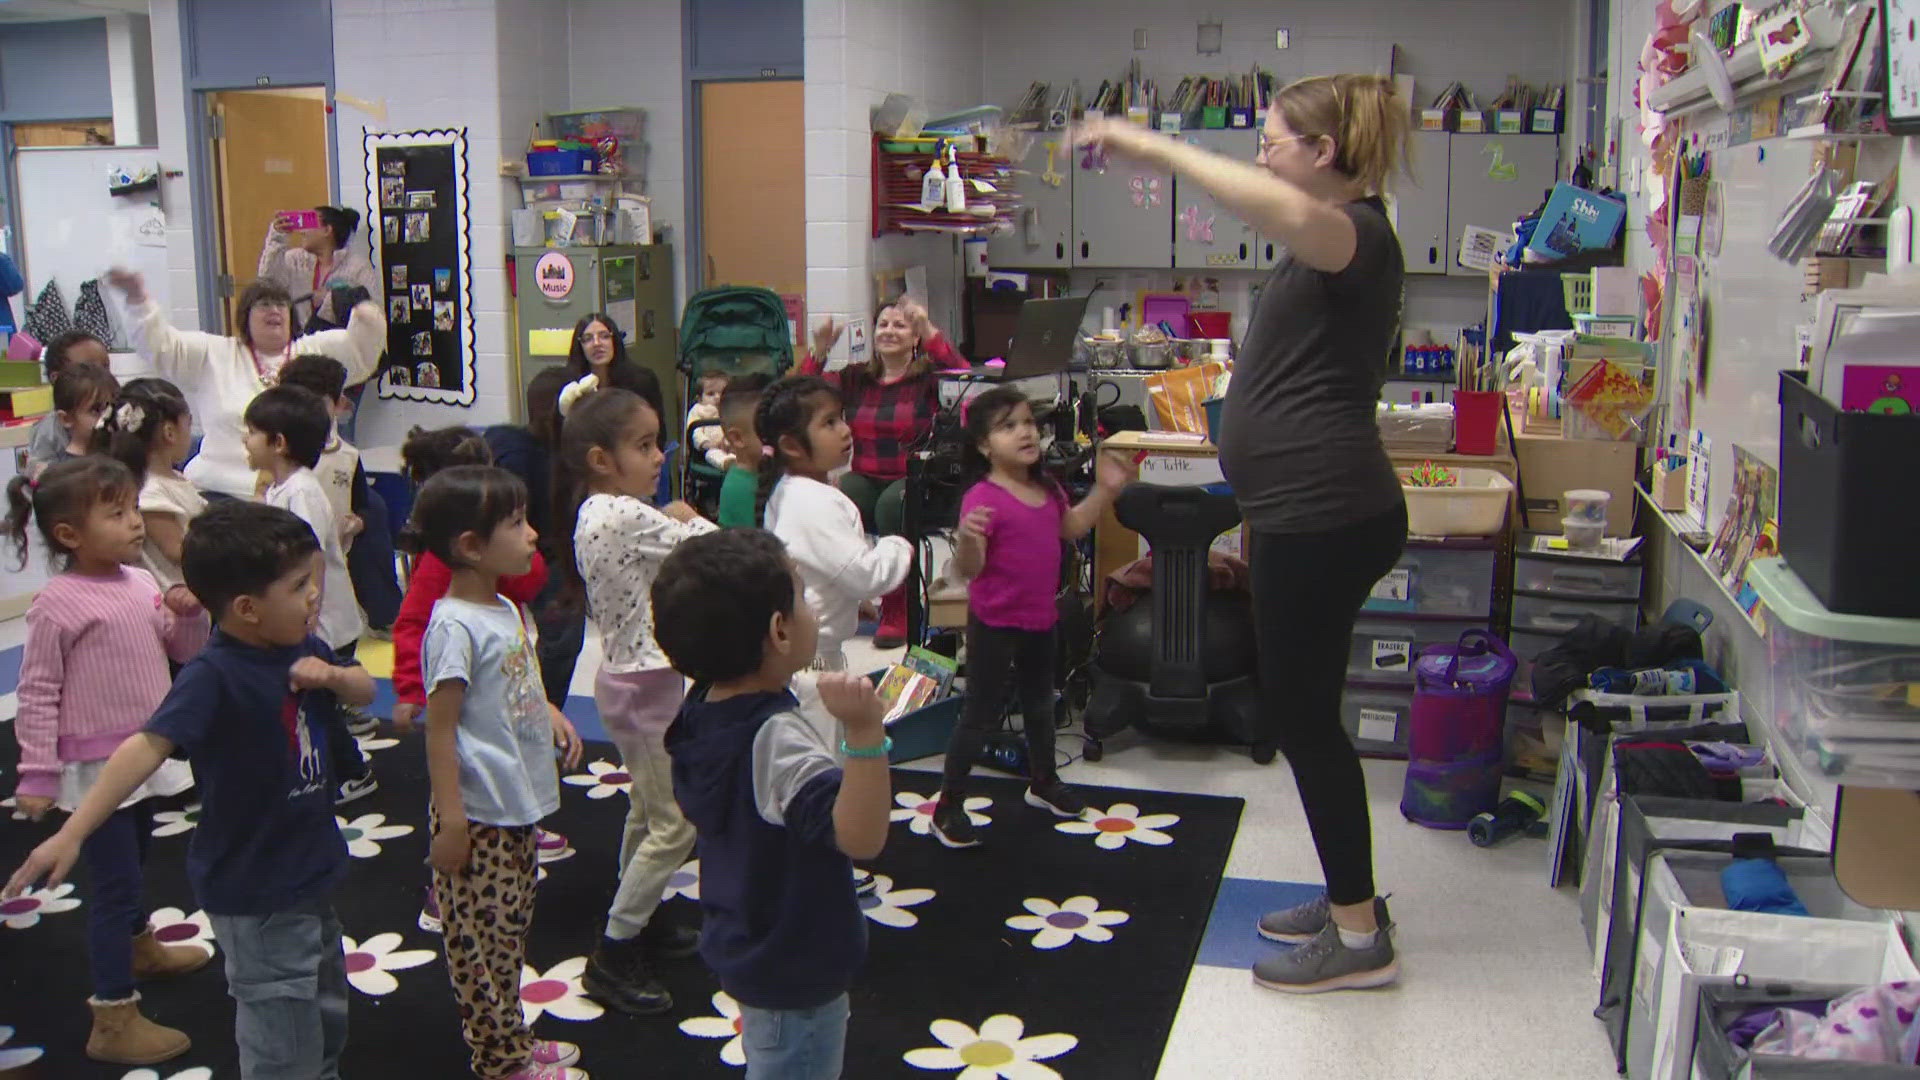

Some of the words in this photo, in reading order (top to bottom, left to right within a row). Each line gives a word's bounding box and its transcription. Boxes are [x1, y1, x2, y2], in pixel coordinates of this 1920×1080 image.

[543, 282, 567, 293] Music
[1144, 459, 1154, 471] Mr
[1377, 641, 1405, 652] ERASERS
